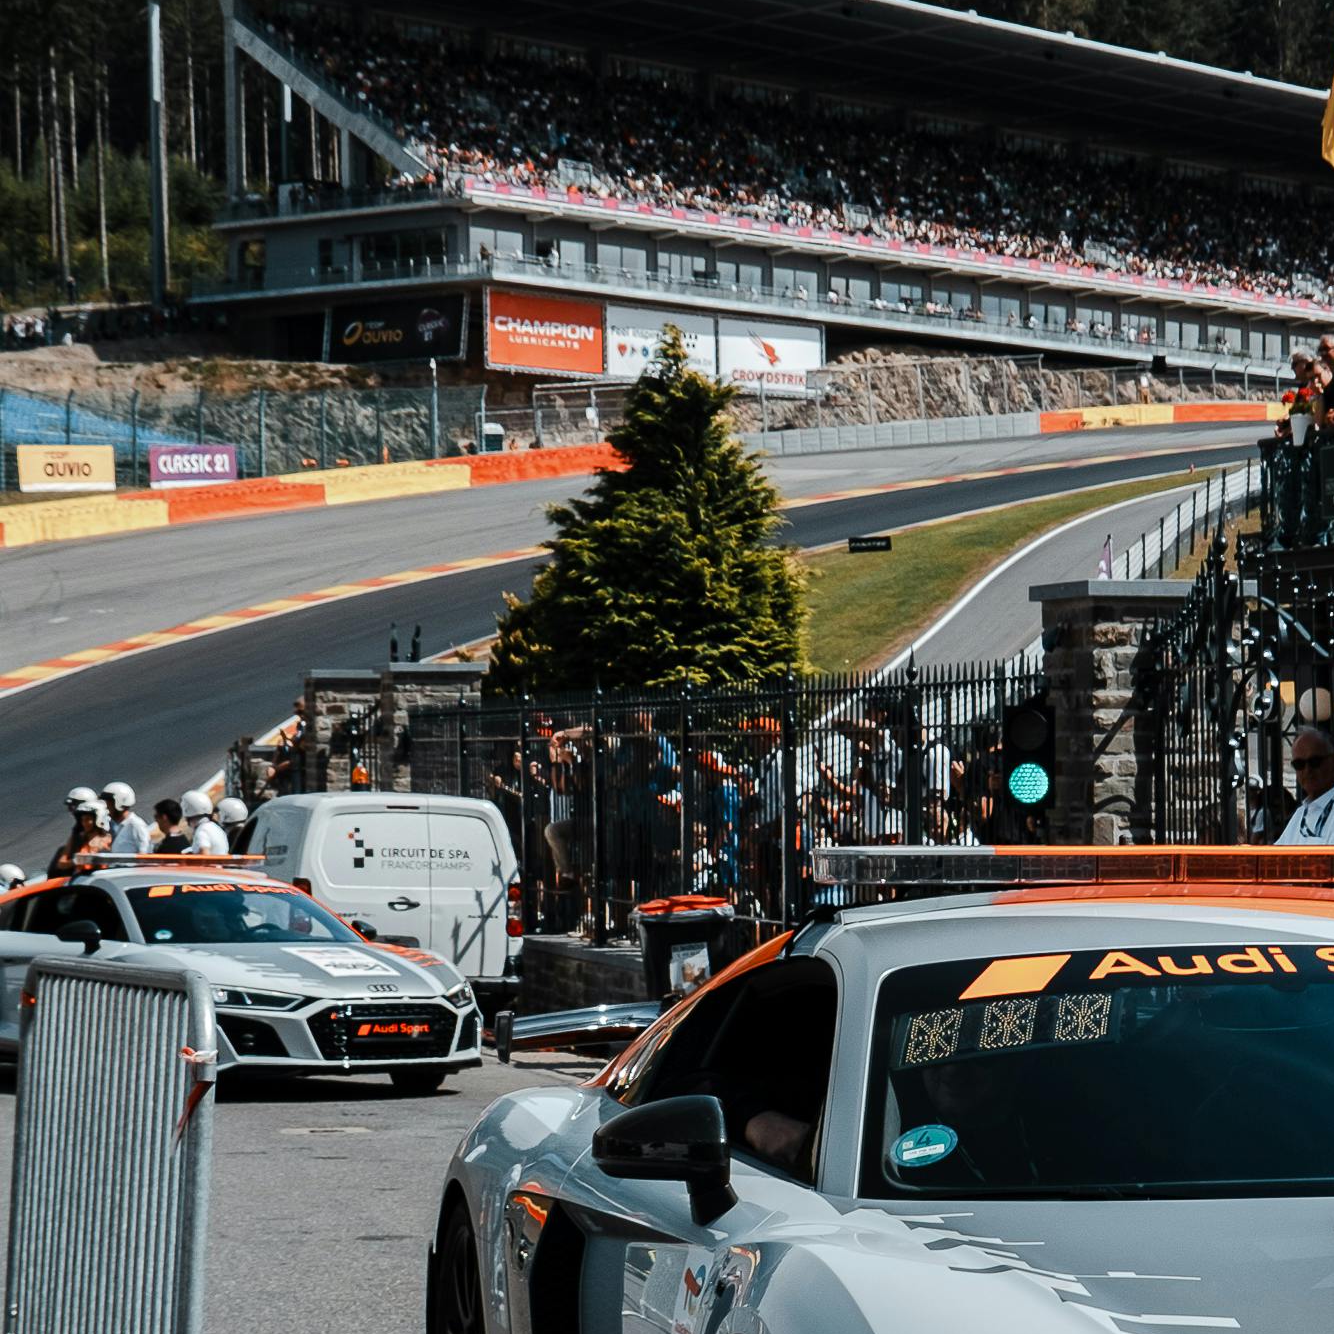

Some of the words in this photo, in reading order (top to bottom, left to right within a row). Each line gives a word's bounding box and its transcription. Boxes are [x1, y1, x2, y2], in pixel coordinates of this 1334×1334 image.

[493, 316, 595, 341] CHAMPION
[508, 334, 580, 349] LUBRICANTS
[43, 462, 92, 477] auvio
[158, 454, 213, 474] CLASSIC
[214, 454, 230, 473] 21
[381, 848, 426, 858] CIRCUIT
[430, 849, 444, 859] DE
[449, 849, 470, 859] SPA
[381, 860, 471, 871] FRANCORCHAMPS
[181, 884, 236, 893] Audi
[1089, 947, 1298, 980] Audi
[372, 1024, 398, 1034] Audi
[400, 1023, 430, 1038] Sport
[916, 1131, 932, 1147] 4
